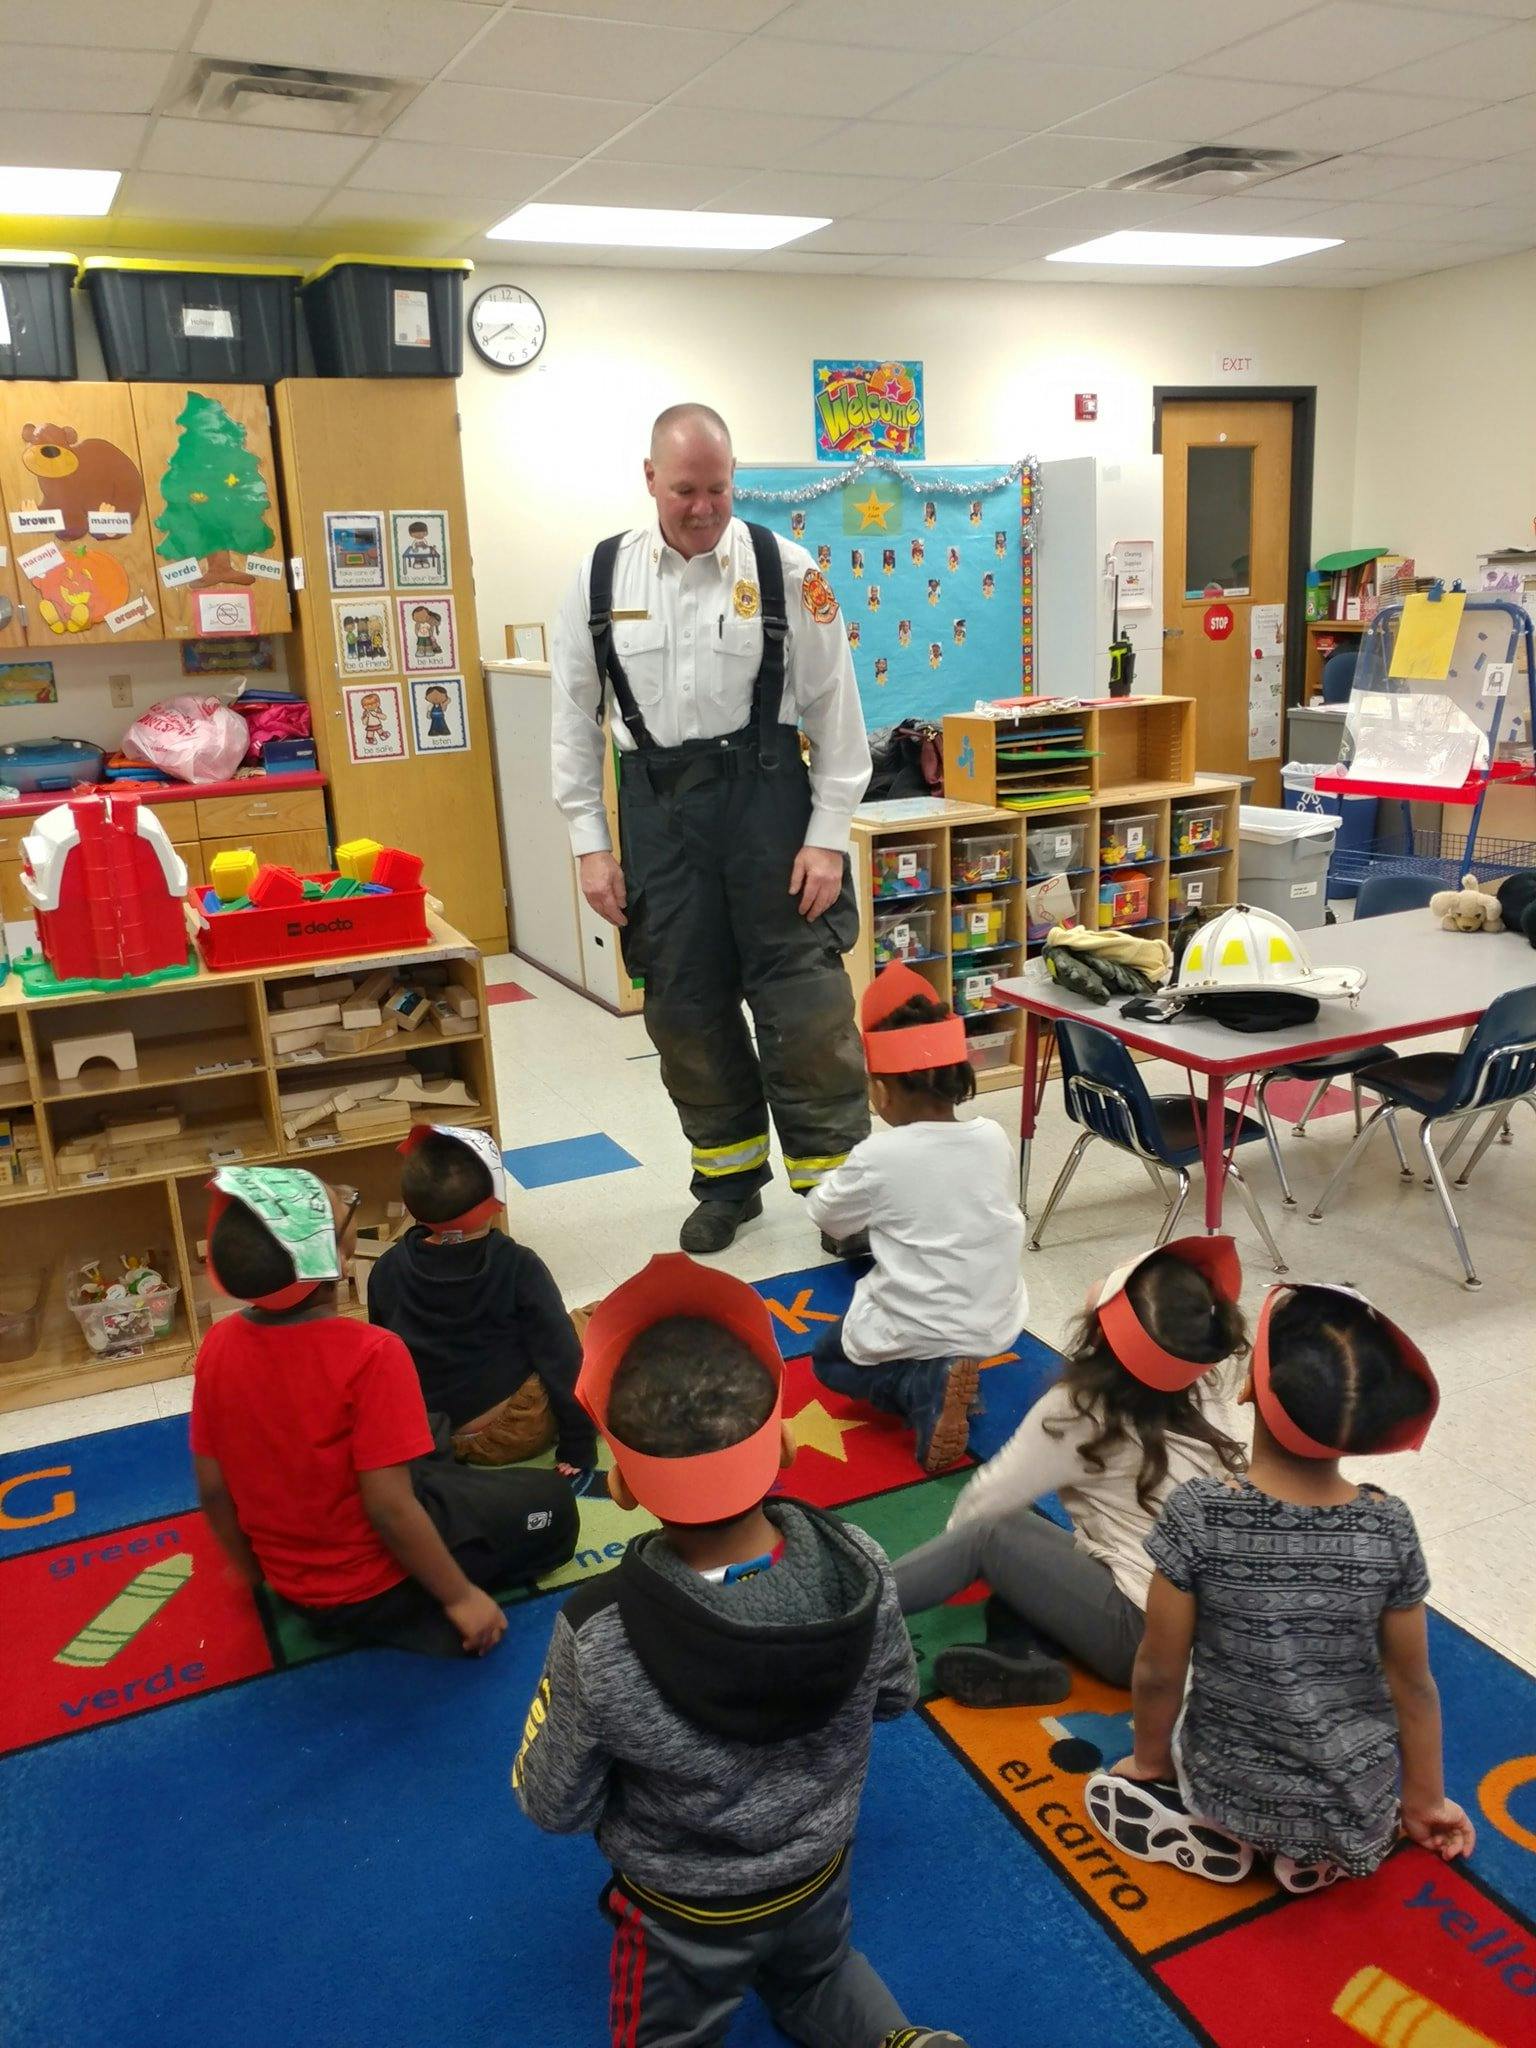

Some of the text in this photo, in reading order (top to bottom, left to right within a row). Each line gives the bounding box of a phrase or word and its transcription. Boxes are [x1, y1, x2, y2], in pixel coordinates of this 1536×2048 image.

[1222, 357, 1252, 371] EXIT
[817, 384, 921, 446] Welcome
[18, 515, 56, 526] brown
[22, 547, 57, 569] naranja
[247, 561, 281, 575] green
[164, 563, 197, 581] verde
[1210, 617, 1229, 631] STOP
[432, 738, 452, 746] listen
[764, 1288, 841, 1335] K
[0, 1465, 76, 1531] G
[48, 1529, 182, 1581] green
[575, 1541, 626, 1568] ne
[59, 1660, 207, 1717] verde
[998, 1759, 1149, 1912] el carro
[1403, 1880, 1536, 1997] yello
